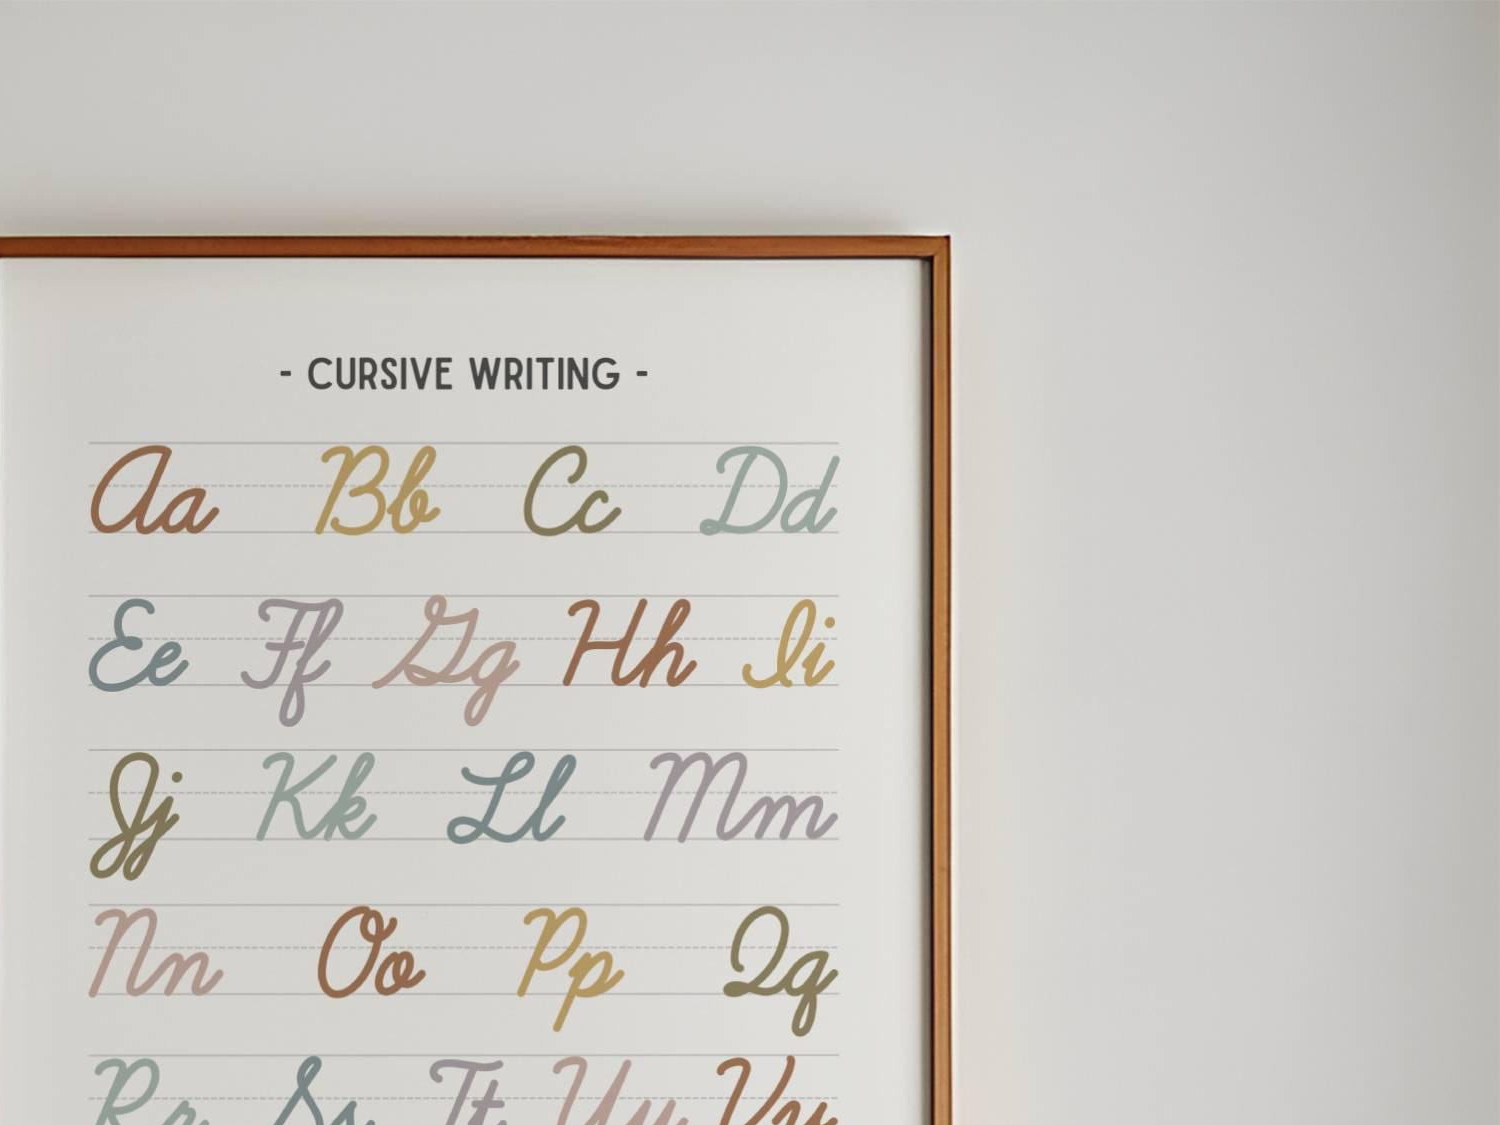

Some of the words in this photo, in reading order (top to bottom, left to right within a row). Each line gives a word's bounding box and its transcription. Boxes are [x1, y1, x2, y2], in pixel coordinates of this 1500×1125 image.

[307, 356, 453, 391] CURSIVE
[468, 356, 621, 391] WRITING
[90, 444, 220, 536] Aa
[314, 444, 441, 537] Bb
[523, 444, 622, 537] Cc
[699, 445, 840, 536] Dd
[88, 598, 189, 693] Ee
[240, 598, 344, 727] Ff
[371, 594, 520, 727] Gg
[562, 598, 698, 689] Hh
[741, 598, 836, 689] Ii
[89, 751, 183, 882] Jj
[256, 751, 377, 842] Kk
[446, 751, 577, 845] Ll
[643, 751, 838, 843] Mm
[88, 907, 224, 998] Nn
[317, 904, 427, 999] Oo
[516, 906, 625, 1033] Pp
[722, 904, 839, 1038] Qq
